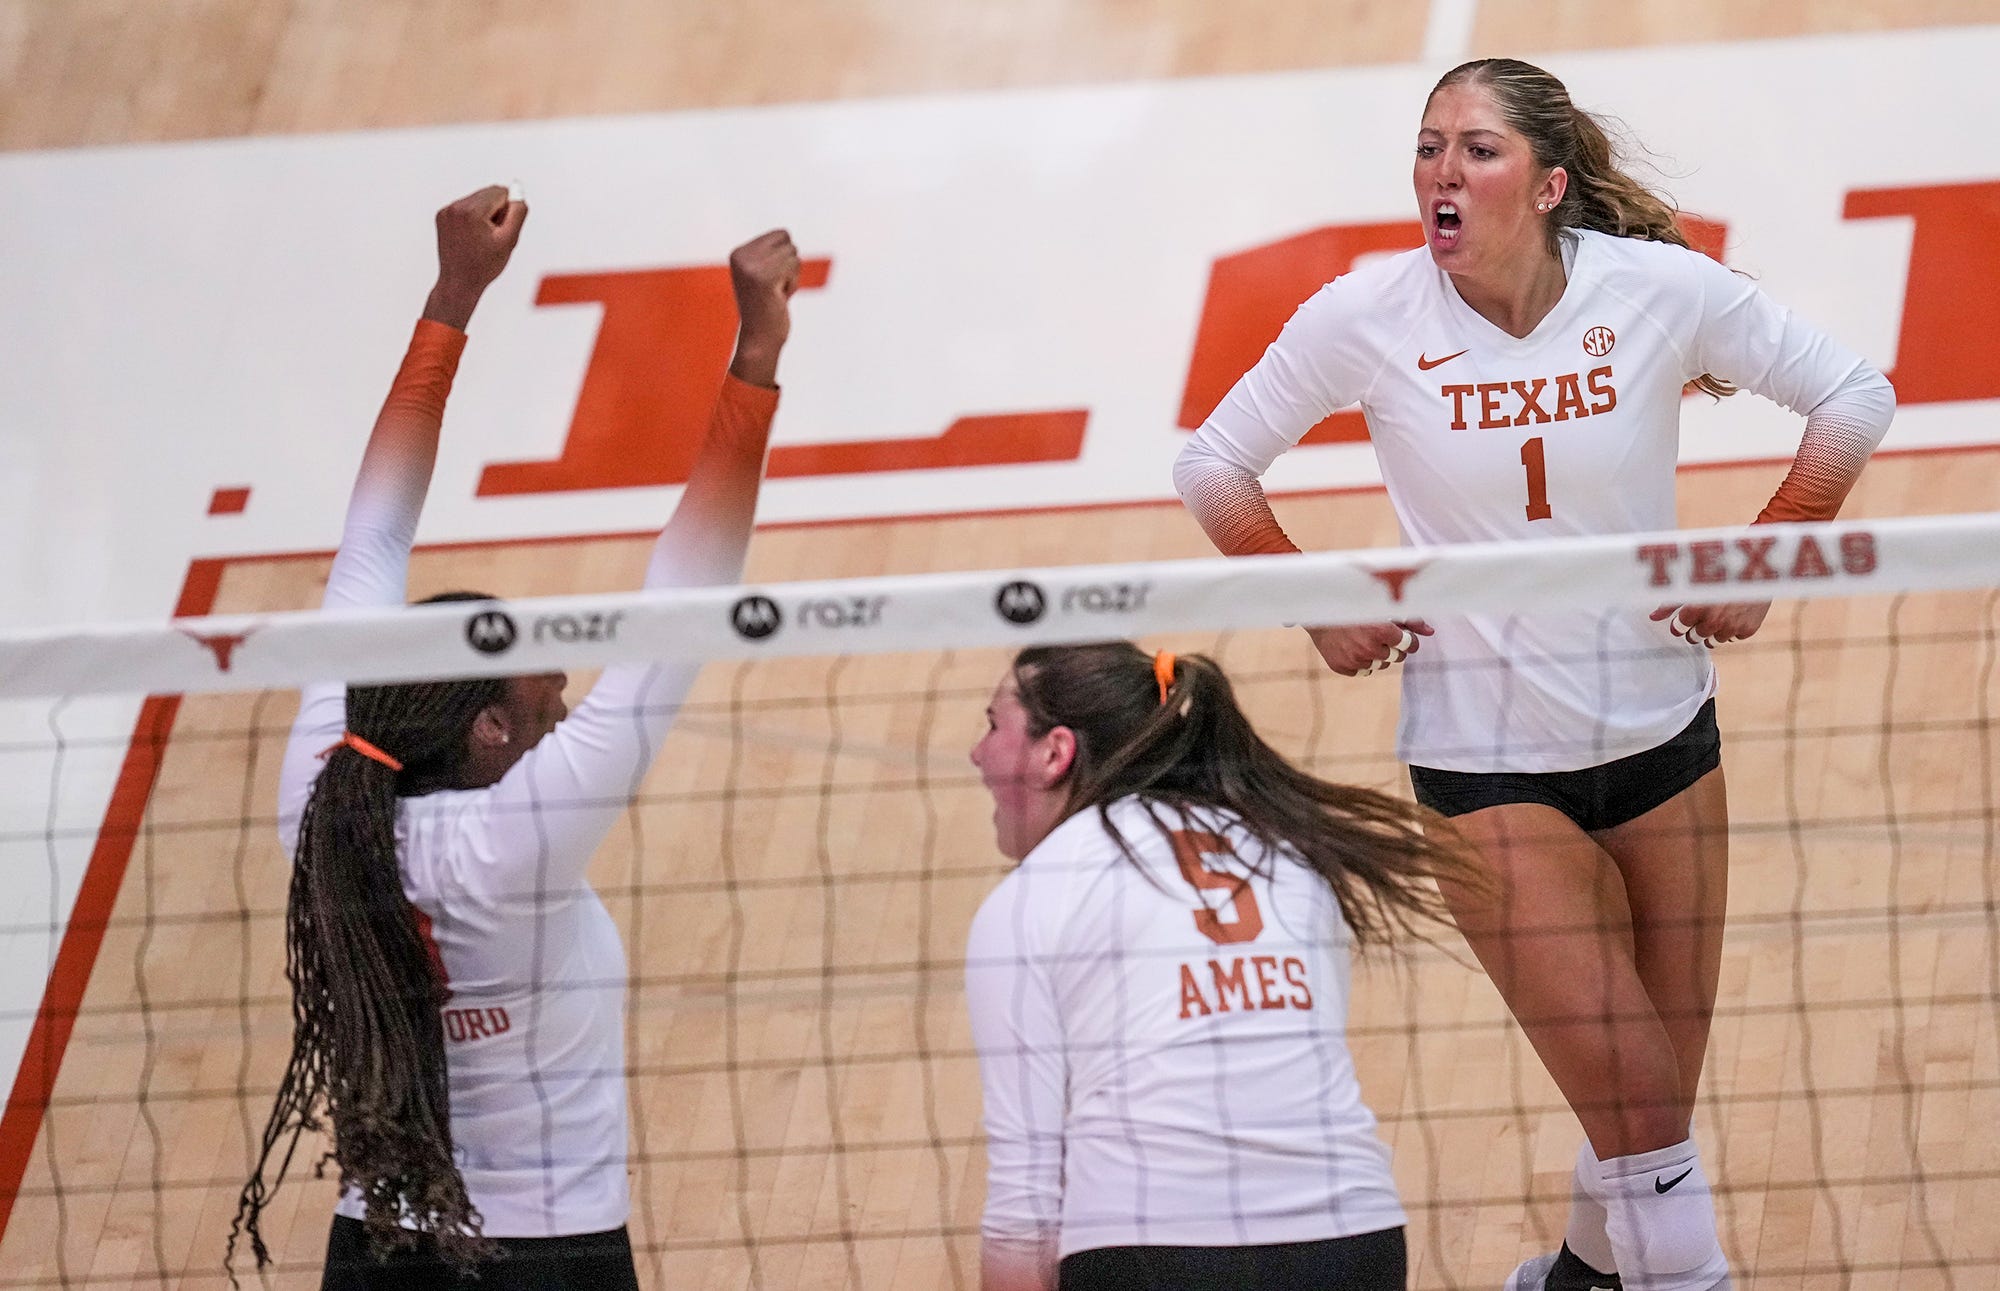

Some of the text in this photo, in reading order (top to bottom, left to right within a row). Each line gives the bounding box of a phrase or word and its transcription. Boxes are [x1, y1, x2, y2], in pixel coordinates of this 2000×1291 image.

[1583, 326, 1616, 357] SEC
[1441, 365, 1617, 430] TEXAS
[1520, 437, 1552, 521] 1
[1637, 532, 1878, 586] TEXAS
[799, 594, 892, 628] razr
[1062, 581, 1152, 612] razr
[533, 611, 626, 645] razr
[1171, 829, 1264, 946] 5
[1179, 956, 1313, 1019] AMES
